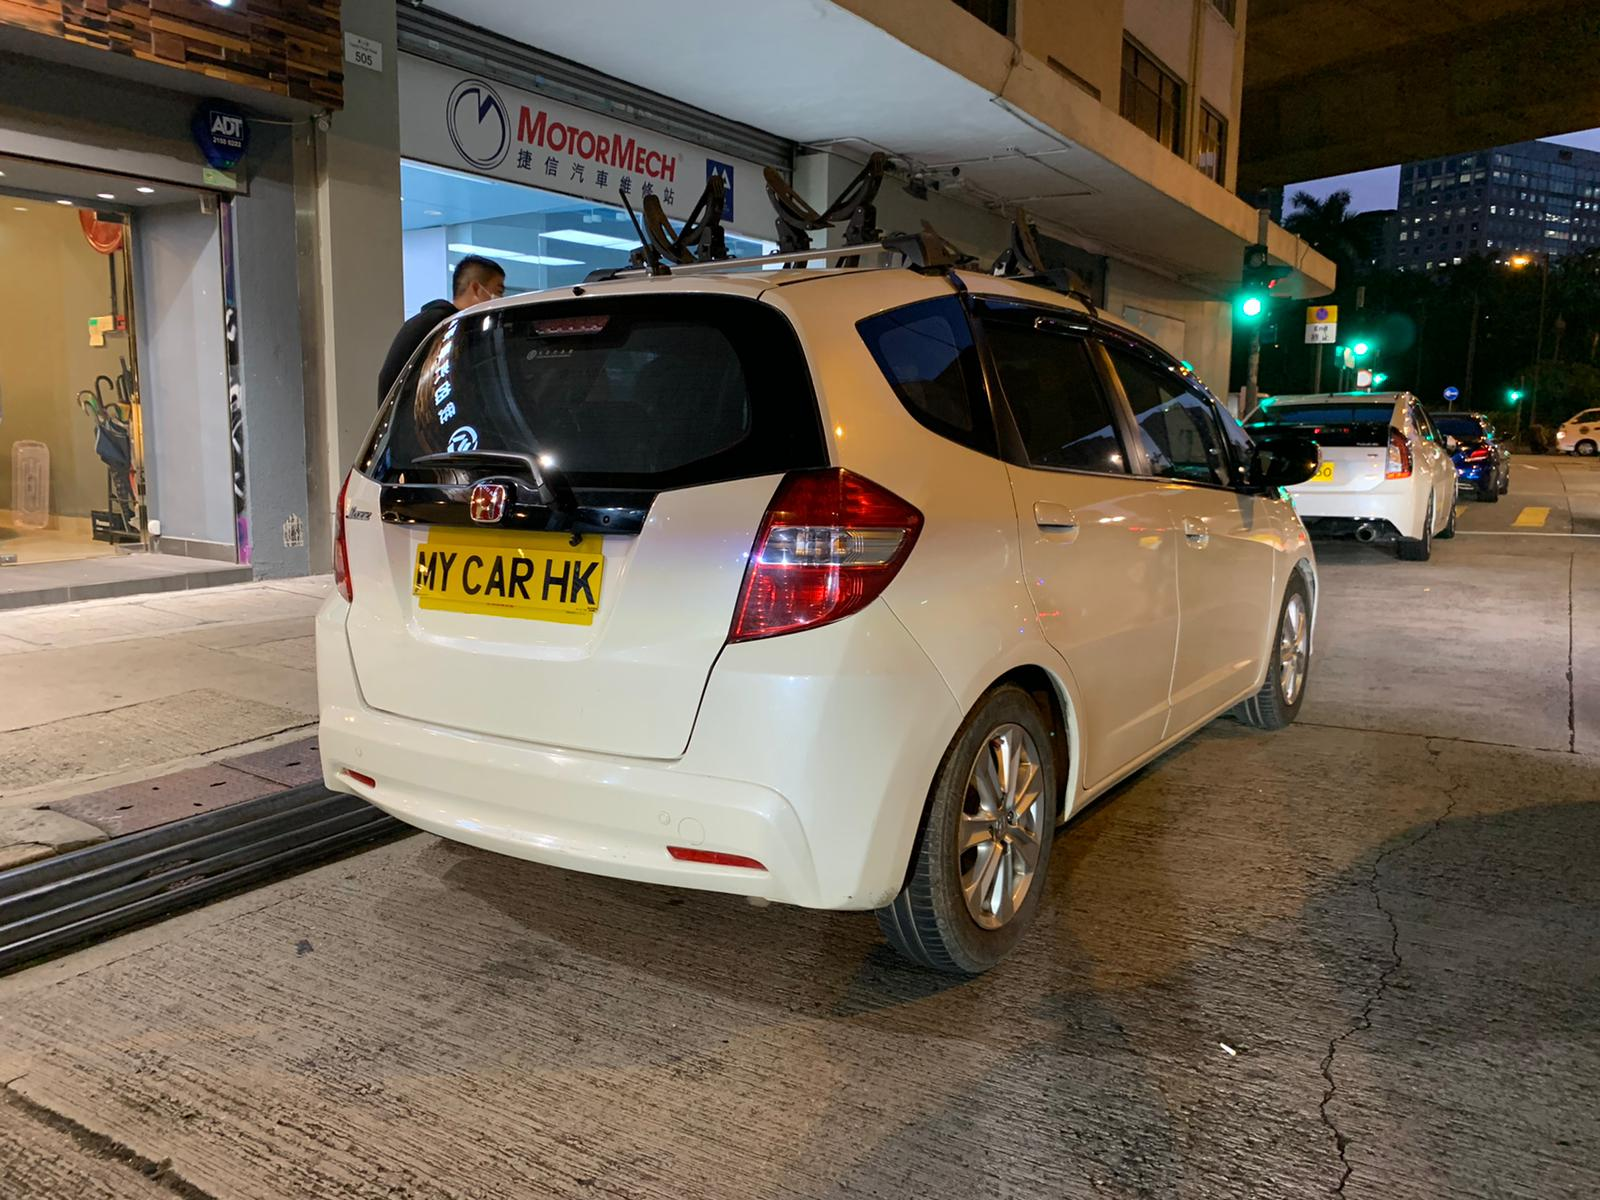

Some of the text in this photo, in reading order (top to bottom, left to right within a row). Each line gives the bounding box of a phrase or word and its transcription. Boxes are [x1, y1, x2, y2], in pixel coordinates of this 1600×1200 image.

[355, 51, 373, 66] 505
[211, 115, 243, 137] ADT
[416, 551, 599, 605] MY CAR HK
